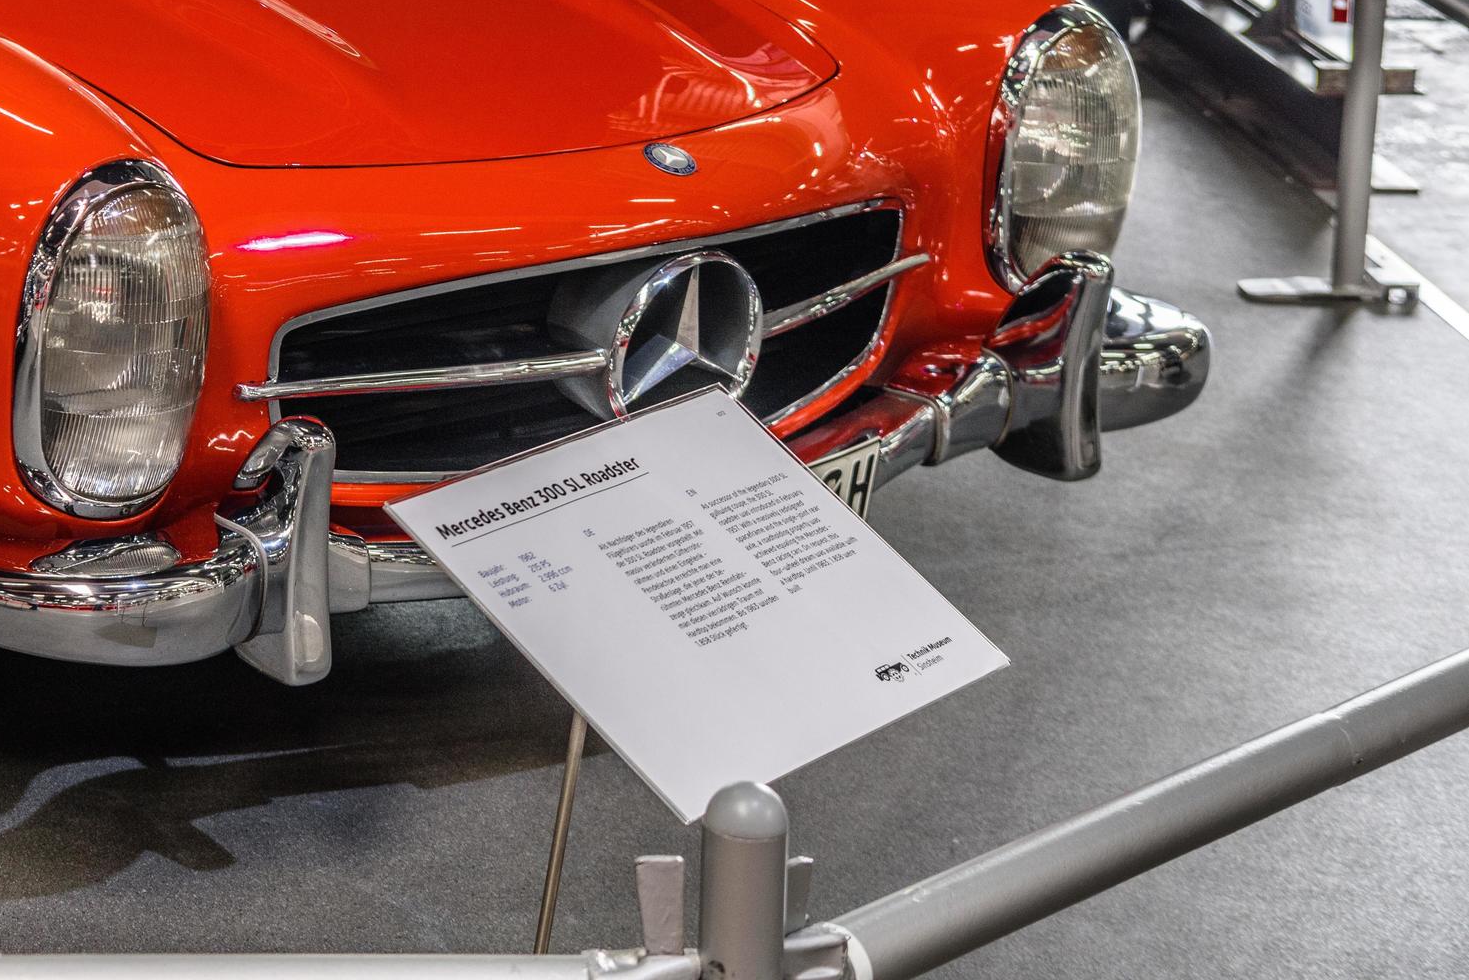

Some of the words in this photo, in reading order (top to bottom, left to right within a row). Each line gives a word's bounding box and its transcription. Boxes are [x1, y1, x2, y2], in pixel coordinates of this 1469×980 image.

[435, 508, 506, 540] Mercedes
[500, 496, 541, 516] Benz
[533, 483, 567, 503] 300
[563, 477, 586, 492] SL
[579, 457, 640, 486] Roadster
[685, 489, 697, 497] EN
[707, 494, 733, 507] successor
[731, 490, 739, 498] of
[768, 475, 781, 484] 300
[754, 491, 767, 500] 300
[739, 510, 751, 518] was
[750, 499, 776, 514] introduced
[583, 528, 595, 537] DE
[680, 520, 694, 530] 1957
[763, 523, 775, 531] and
[803, 525, 829, 538] Mercedes
[598, 543, 609, 551] Als
[606, 533, 635, 547] Nachfolger
[634, 530, 646, 538] des
[624, 555, 638, 565] 300
[642, 545, 667, 557] Roadster
[761, 558, 777, 568] Benz
[681, 588, 709, 603] Mercedes
[706, 582, 723, 592] Benz
[906, 646, 930, 660] Technik
[927, 637, 952, 651] Museum
[916, 655, 944, 671] Sinsheim
